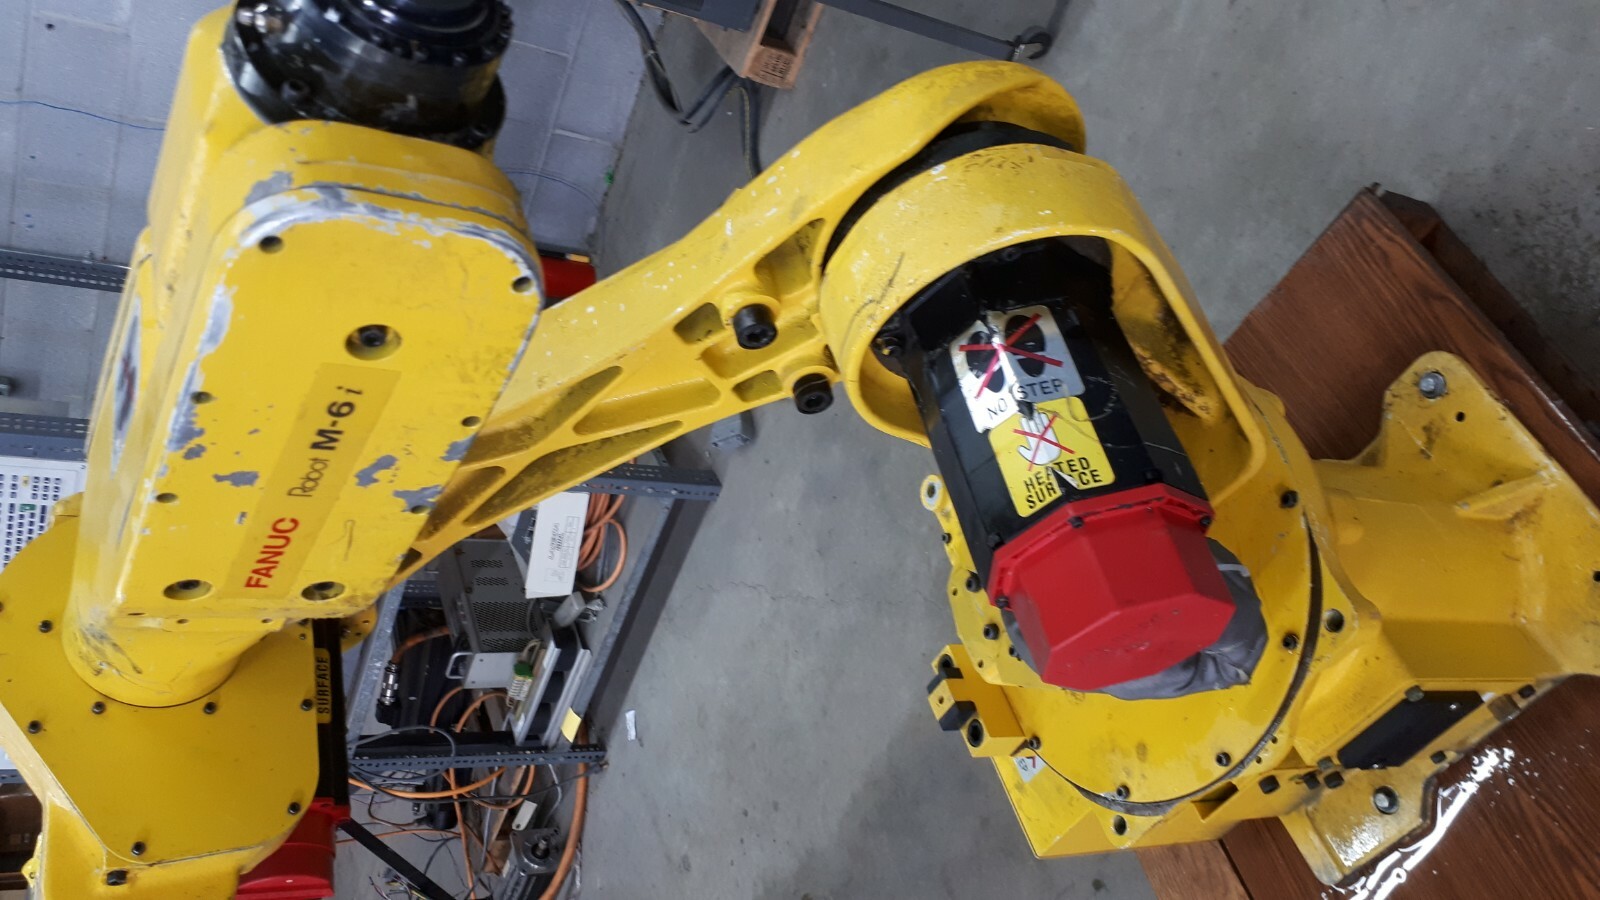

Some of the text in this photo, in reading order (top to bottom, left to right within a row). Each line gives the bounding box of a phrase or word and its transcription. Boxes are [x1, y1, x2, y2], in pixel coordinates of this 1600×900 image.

[987, 378, 1063, 420] NO STEP
[1026, 469, 1102, 510] SURCE
[245, 517, 299, 588] FANUC
[287, 458, 330, 498] Robot
[317, 656, 330, 714] SURFACE
